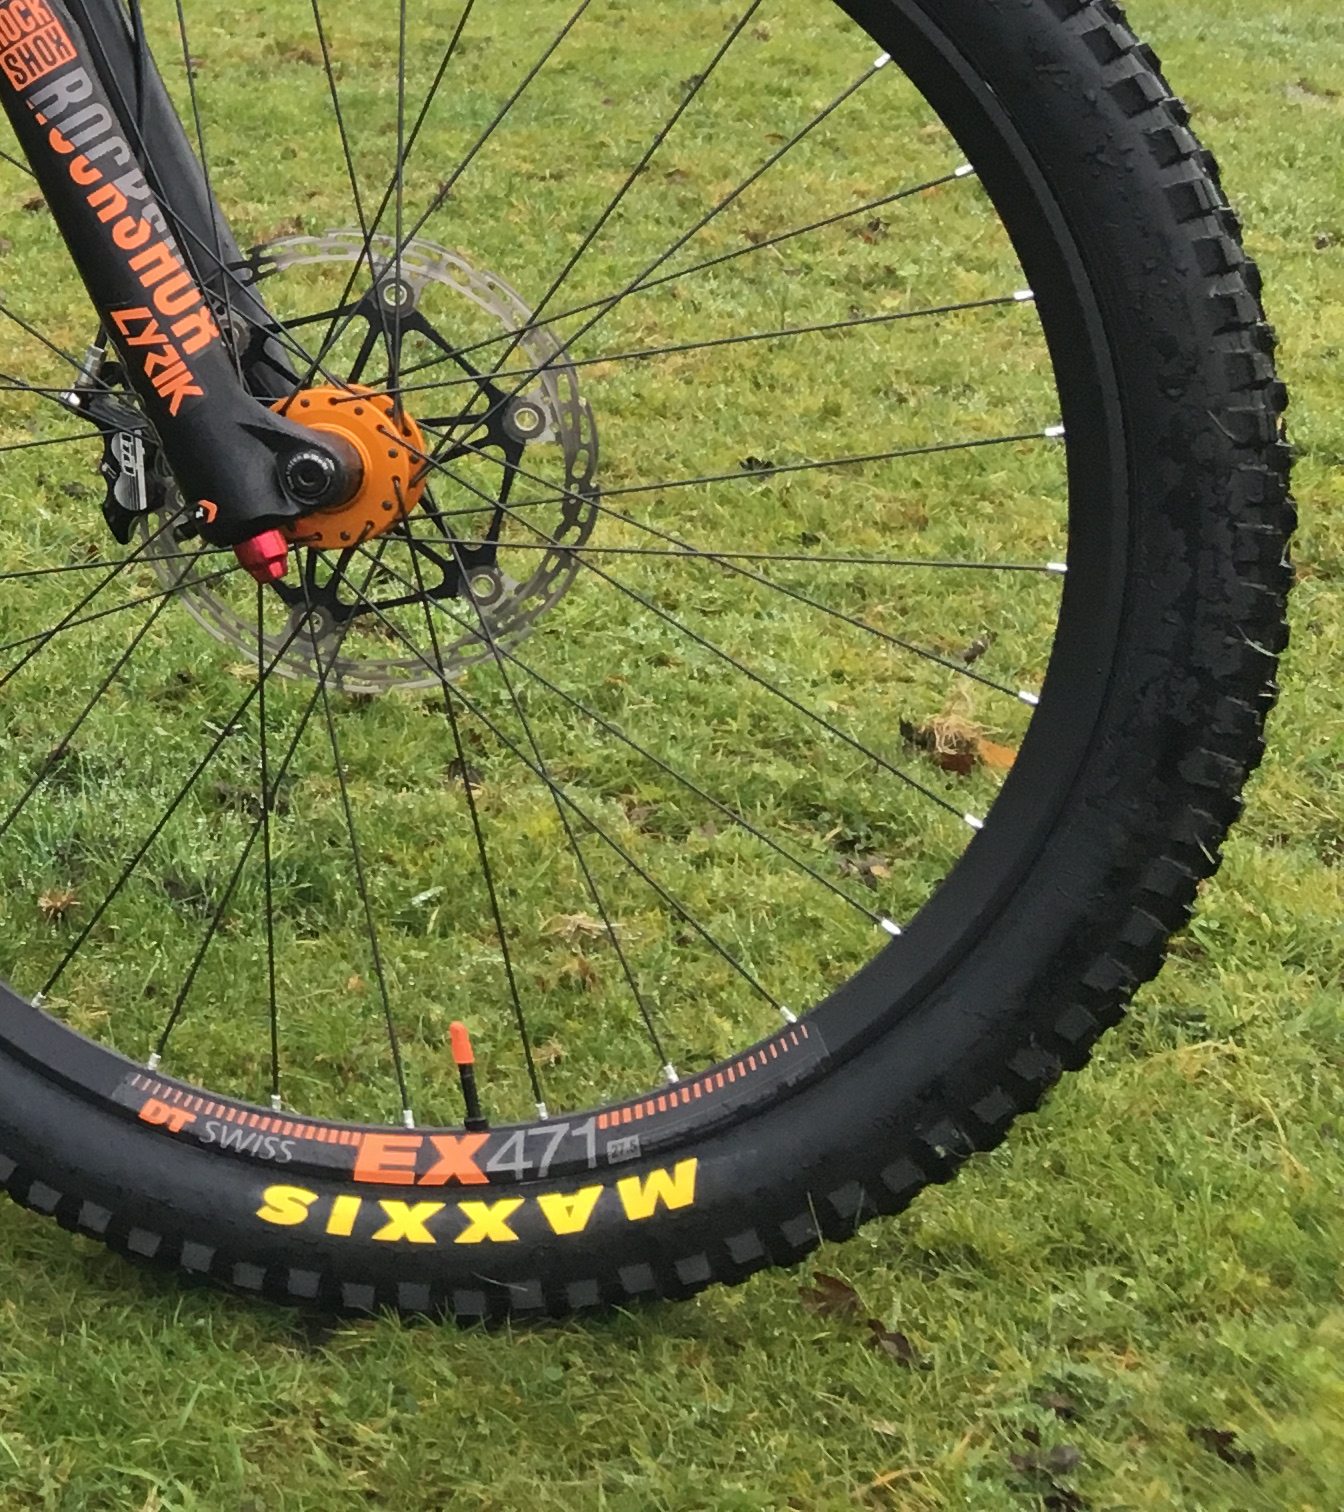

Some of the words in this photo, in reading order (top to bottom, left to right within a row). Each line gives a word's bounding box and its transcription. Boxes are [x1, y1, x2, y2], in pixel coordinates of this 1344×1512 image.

[2, 19, 77, 89] SHOX
[26, 66, 220, 354] ROCKSHOX
[137, 1096, 198, 1134] DT
[199, 1119, 296, 1164] SWISS
[255, 1156, 699, 1244] MAXXIS
